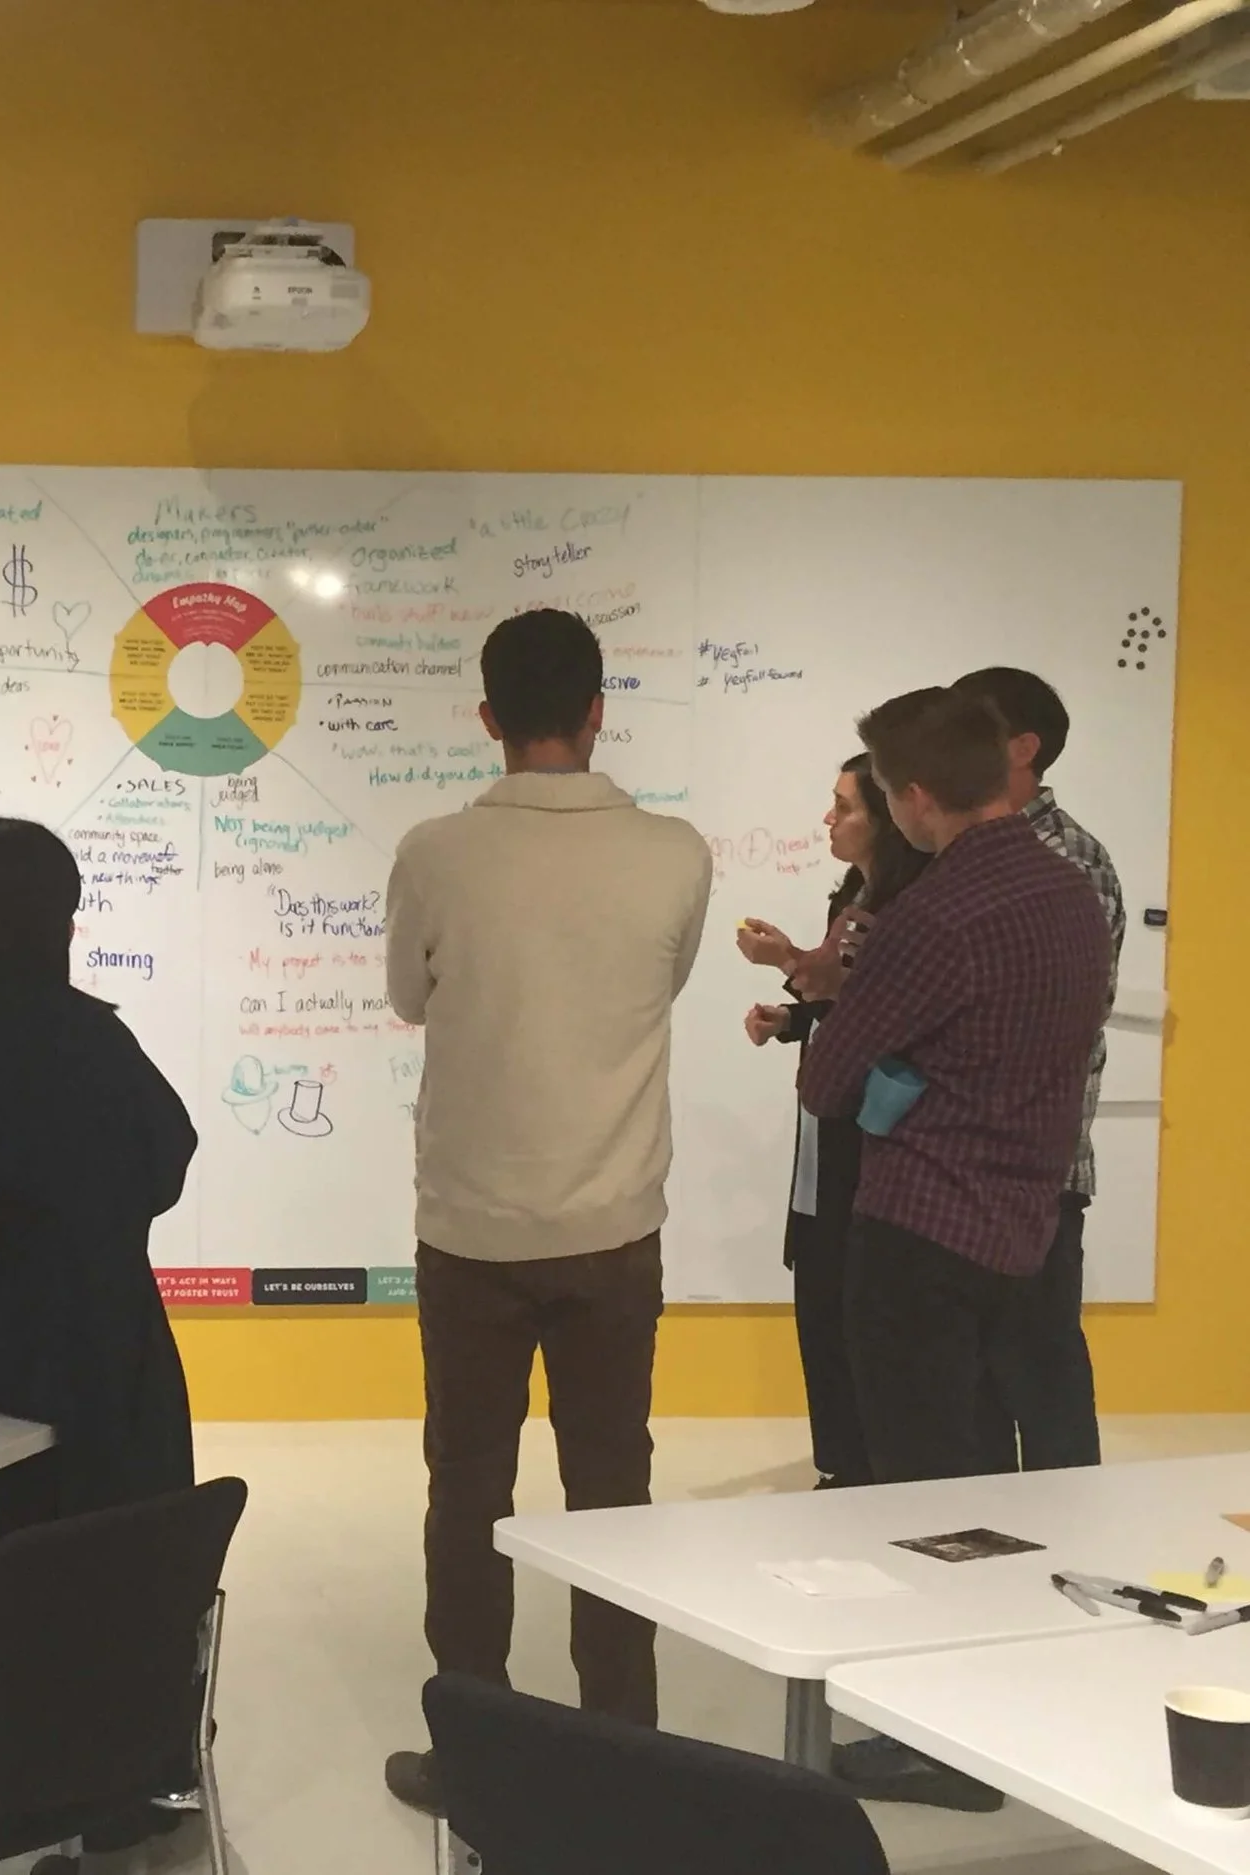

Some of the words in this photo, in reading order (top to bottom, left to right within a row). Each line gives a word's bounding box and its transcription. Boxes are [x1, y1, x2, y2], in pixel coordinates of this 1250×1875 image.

[414, 656, 462, 677] channel
[602, 676, 641, 690] usive
[328, 718, 360, 732] with
[366, 718, 399, 732] care
[369, 764, 400, 786] How
[126, 777, 187, 796] SALES
[214, 815, 246, 832] NOT
[253, 819, 291, 842] being
[98, 851, 108, 864] a
[214, 861, 245, 884] being
[310, 892, 339, 916] this
[340, 890, 381, 914] work?
[301, 917, 315, 934] it
[87, 946, 154, 981] sharing
[277, 990, 287, 1013] I
[295, 989, 353, 1021] actually
[362, 994, 394, 1011] mak
[156, 1277, 177, 1285] ET'S
[179, 1277, 196, 1285] ACT
[211, 1277, 238, 1285] WAYS
[264, 1283, 289, 1292] LET'S
[291, 1283, 303, 1291] BE
[304, 1282, 355, 1291] OURSELVES
[174, 1289, 209, 1297] FOSTER
[211, 1289, 240, 1297] TRUST
